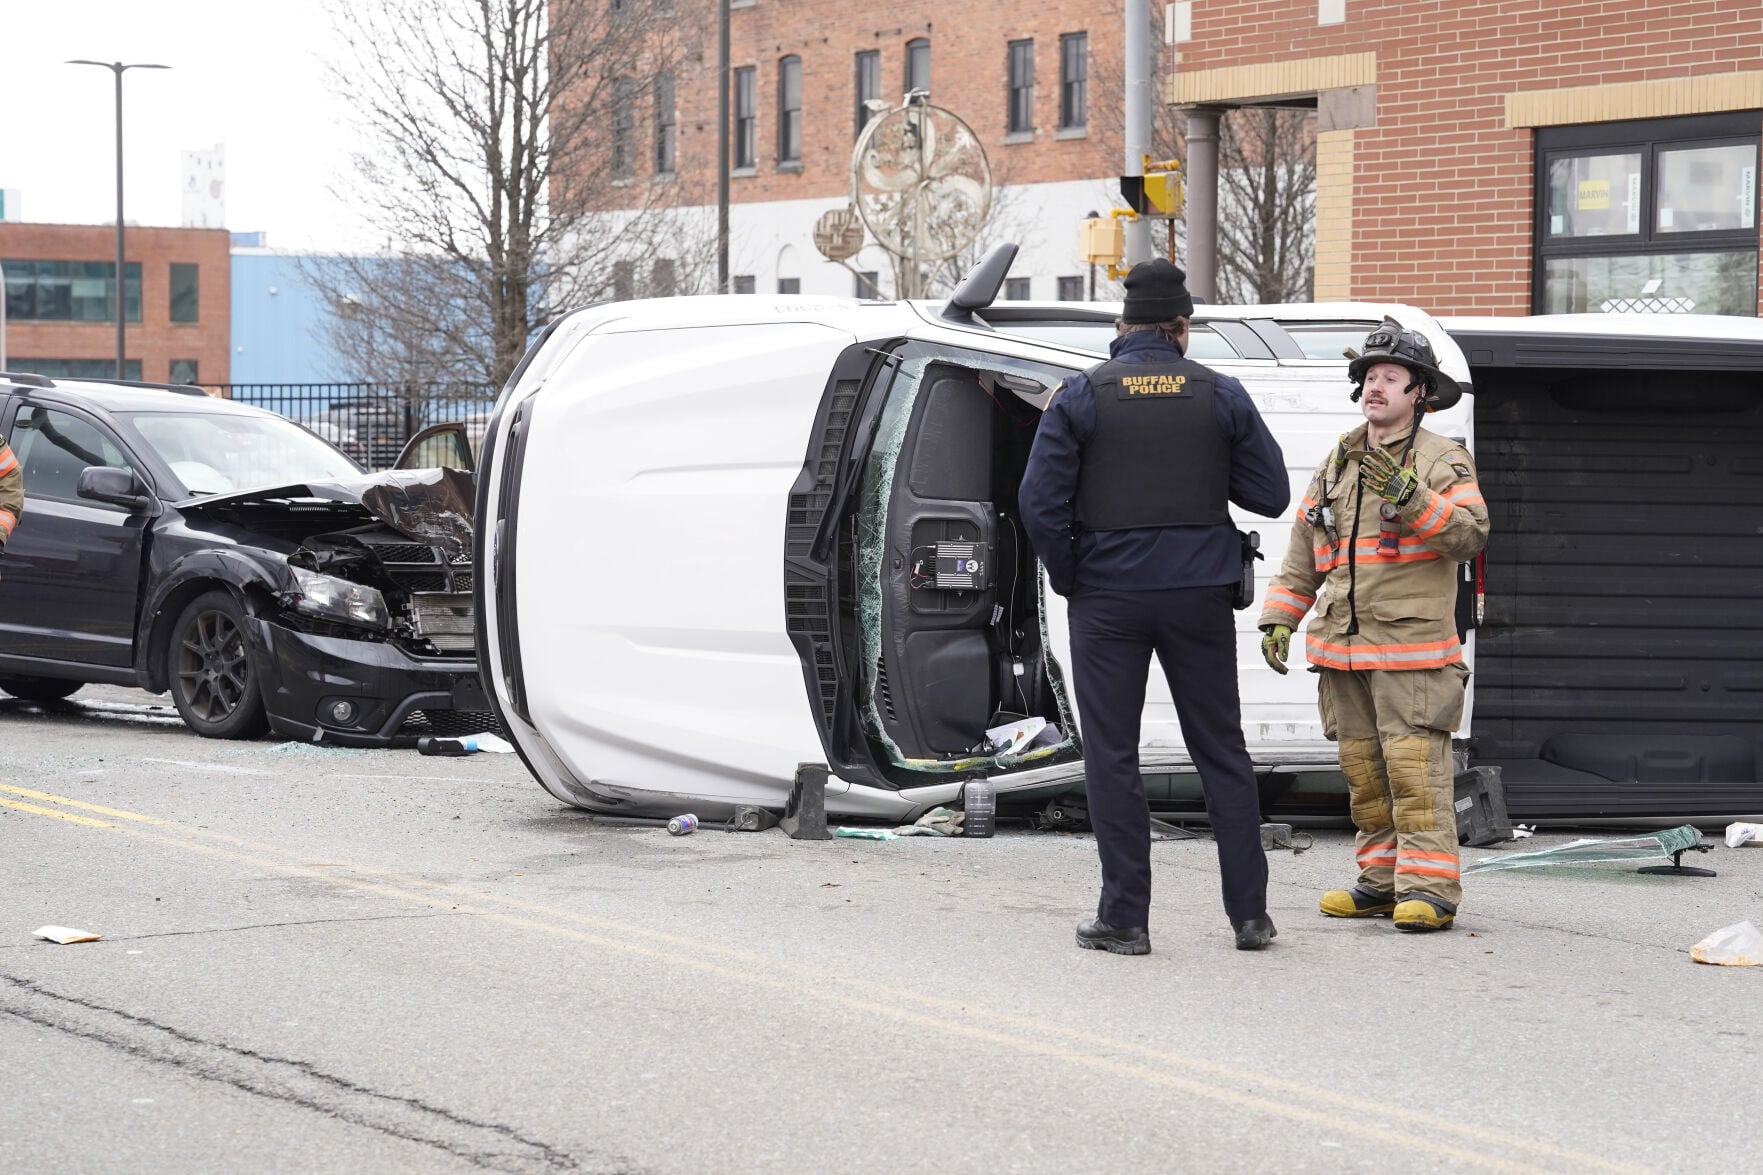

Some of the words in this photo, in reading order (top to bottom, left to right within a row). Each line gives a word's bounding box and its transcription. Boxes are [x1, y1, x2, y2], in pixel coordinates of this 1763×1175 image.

[1579, 189, 1609, 201] MARVIN
[1122, 375, 1186, 386] BUFFALO
[1129, 384, 1181, 395] POLICE
